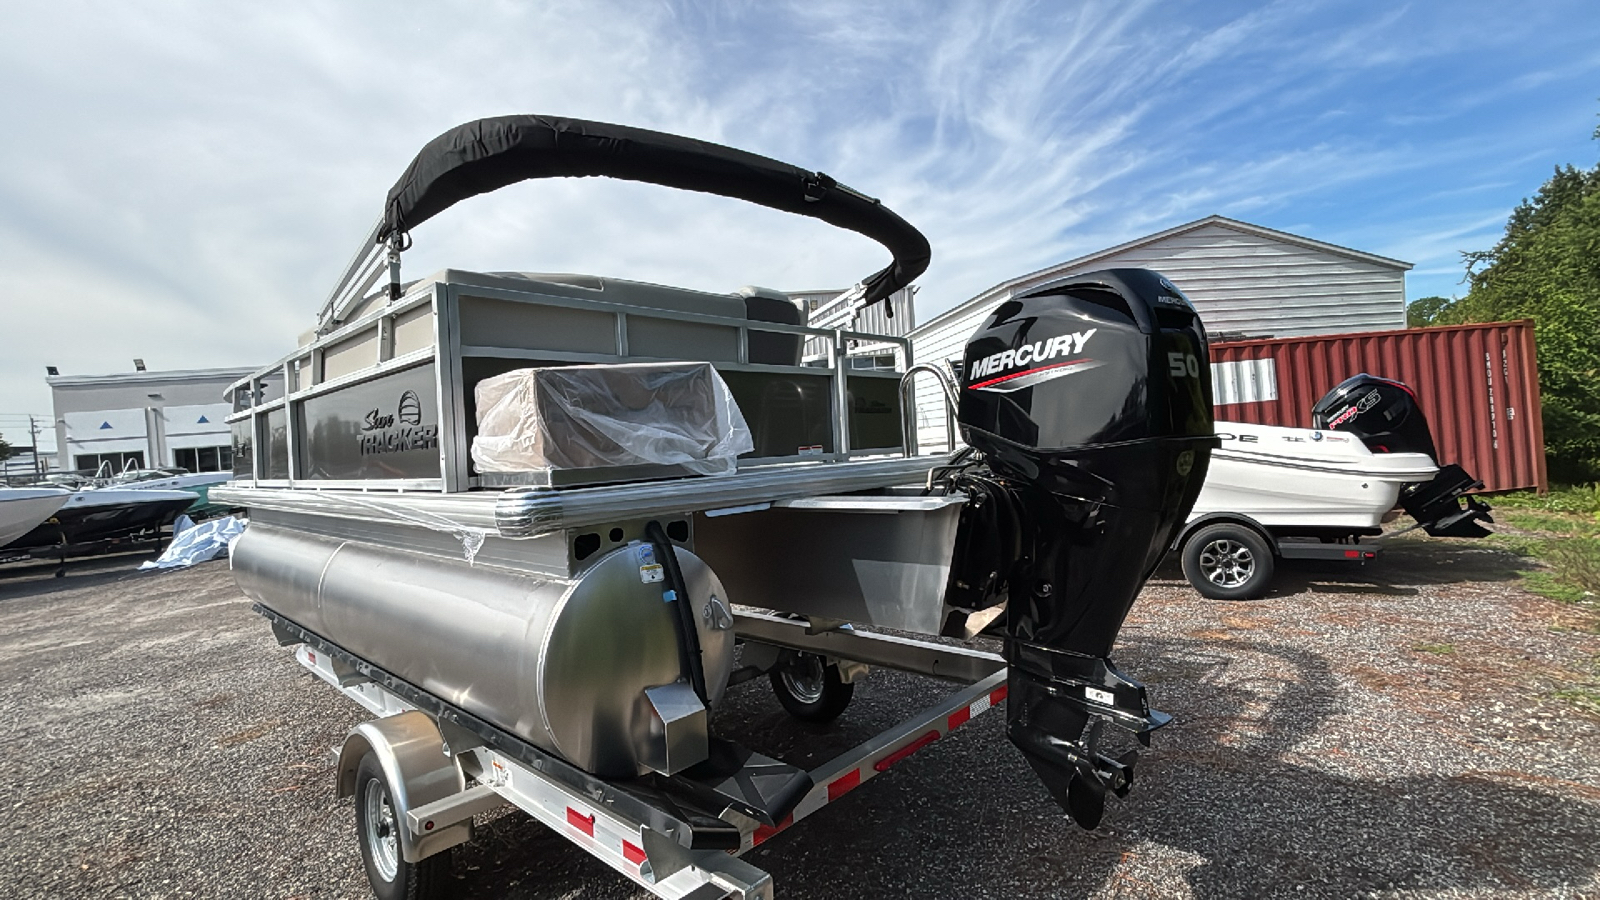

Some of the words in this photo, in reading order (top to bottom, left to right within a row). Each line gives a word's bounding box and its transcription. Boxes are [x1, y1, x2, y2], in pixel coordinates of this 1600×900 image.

[969, 328, 1098, 381] MERCURY
[1167, 352, 1200, 378] 50
[361, 407, 395, 431] Sun
[356, 424, 438, 456] TRACKER
